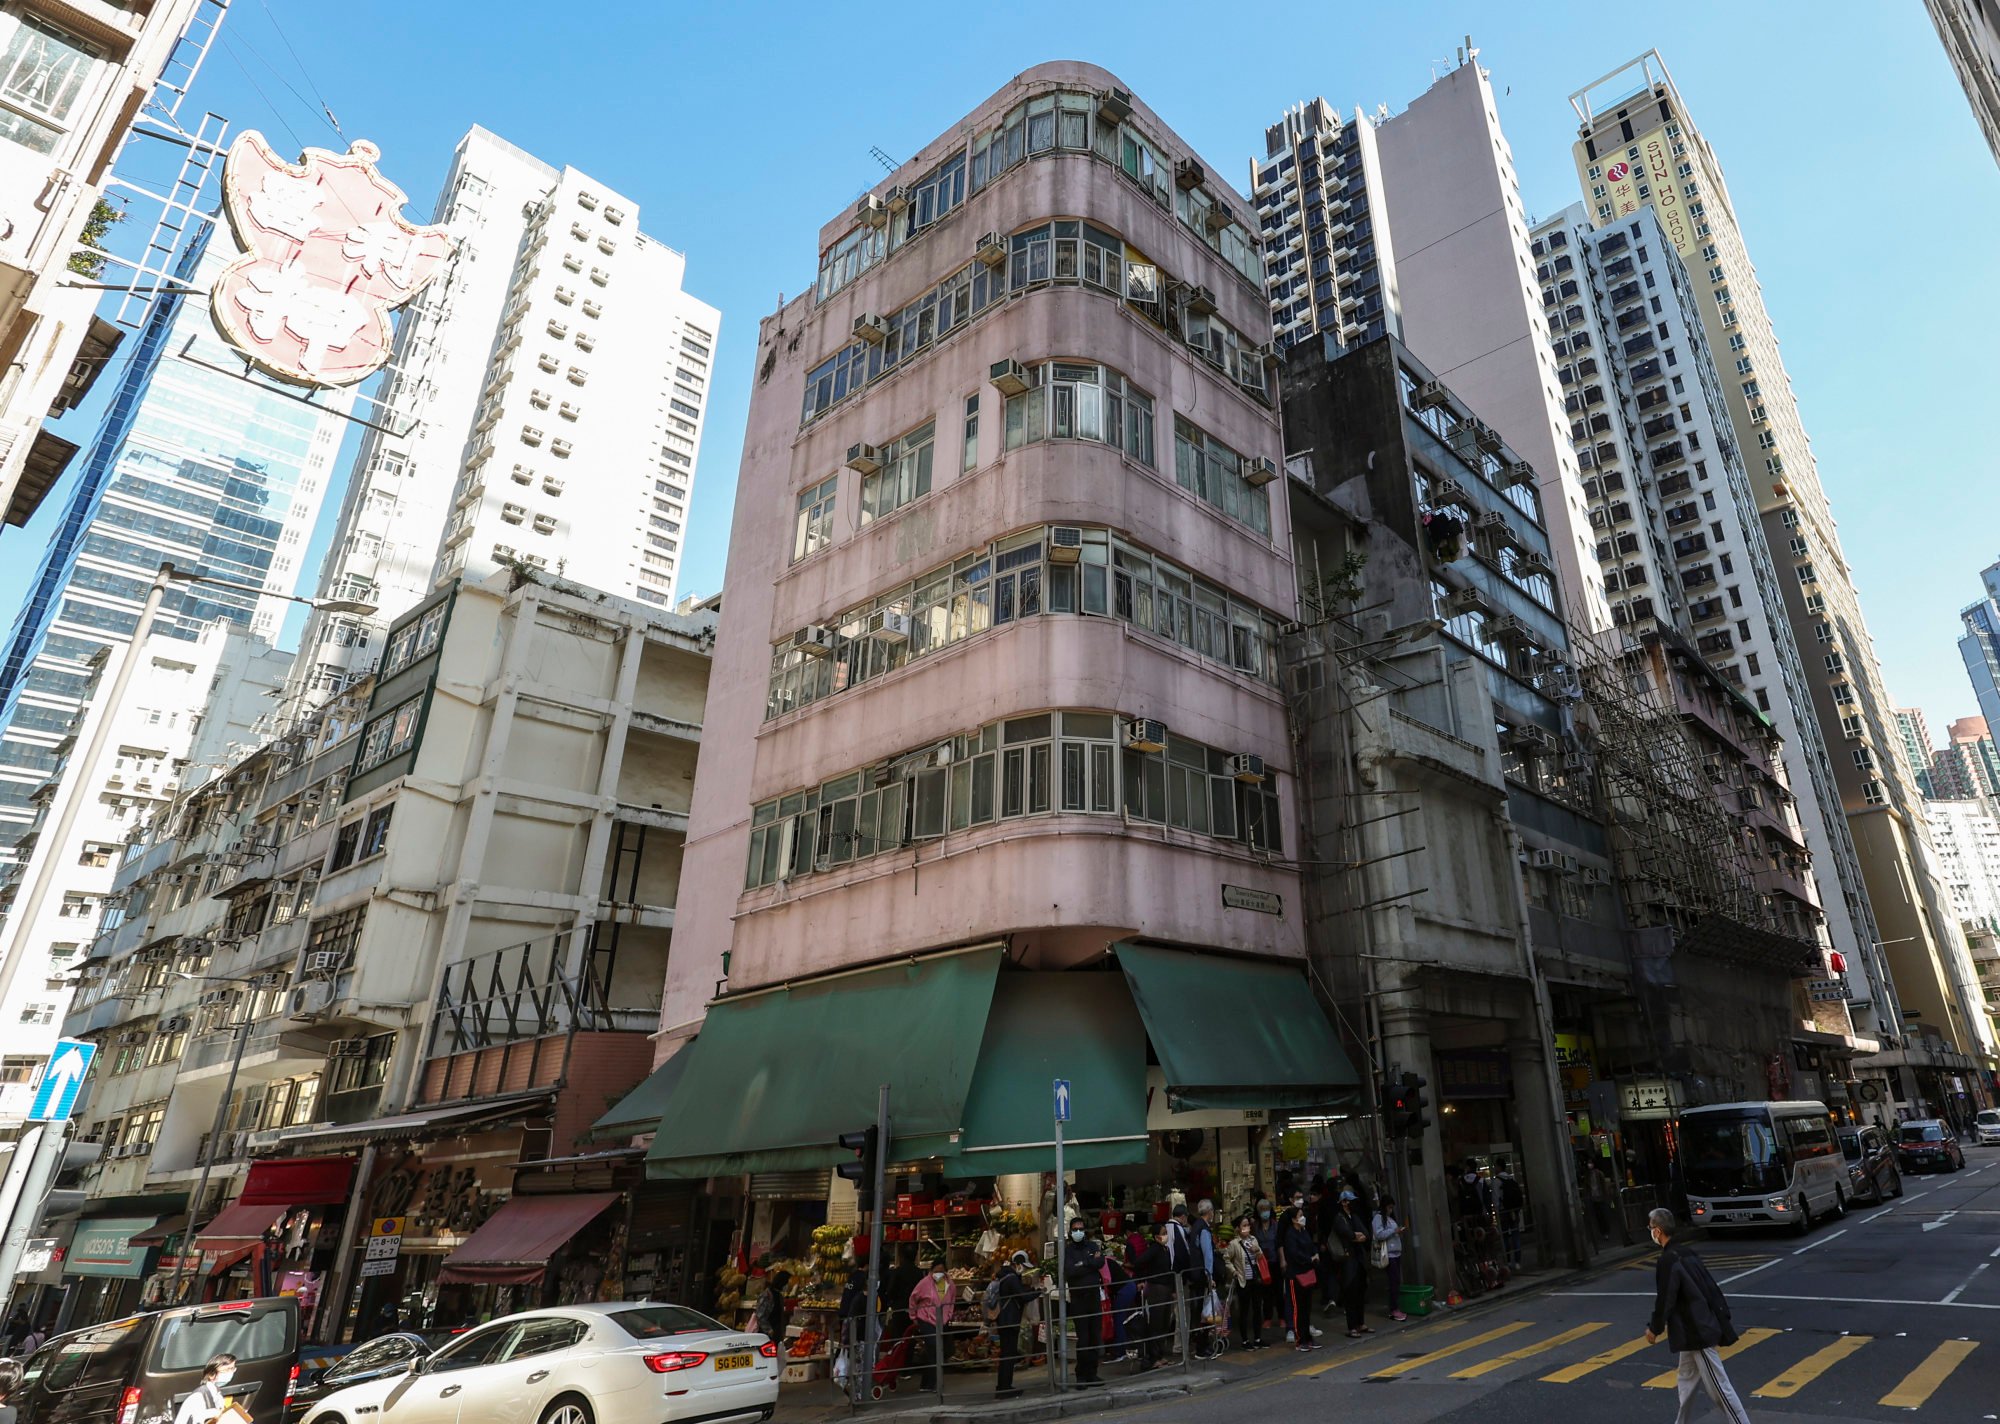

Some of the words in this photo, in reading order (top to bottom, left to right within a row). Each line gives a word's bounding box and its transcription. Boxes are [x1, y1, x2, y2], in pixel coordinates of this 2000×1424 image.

[1615, 184, 1636, 216] 华美
[1647, 141, 1668, 182] SHUN
[1659, 184, 1675, 207] HO
[1667, 209, 1687, 253] GROUP
[82, 1237, 116, 1255] watsons
[718, 1359, 729, 1369] SG
[731, 1356, 750, 1368] 5108
